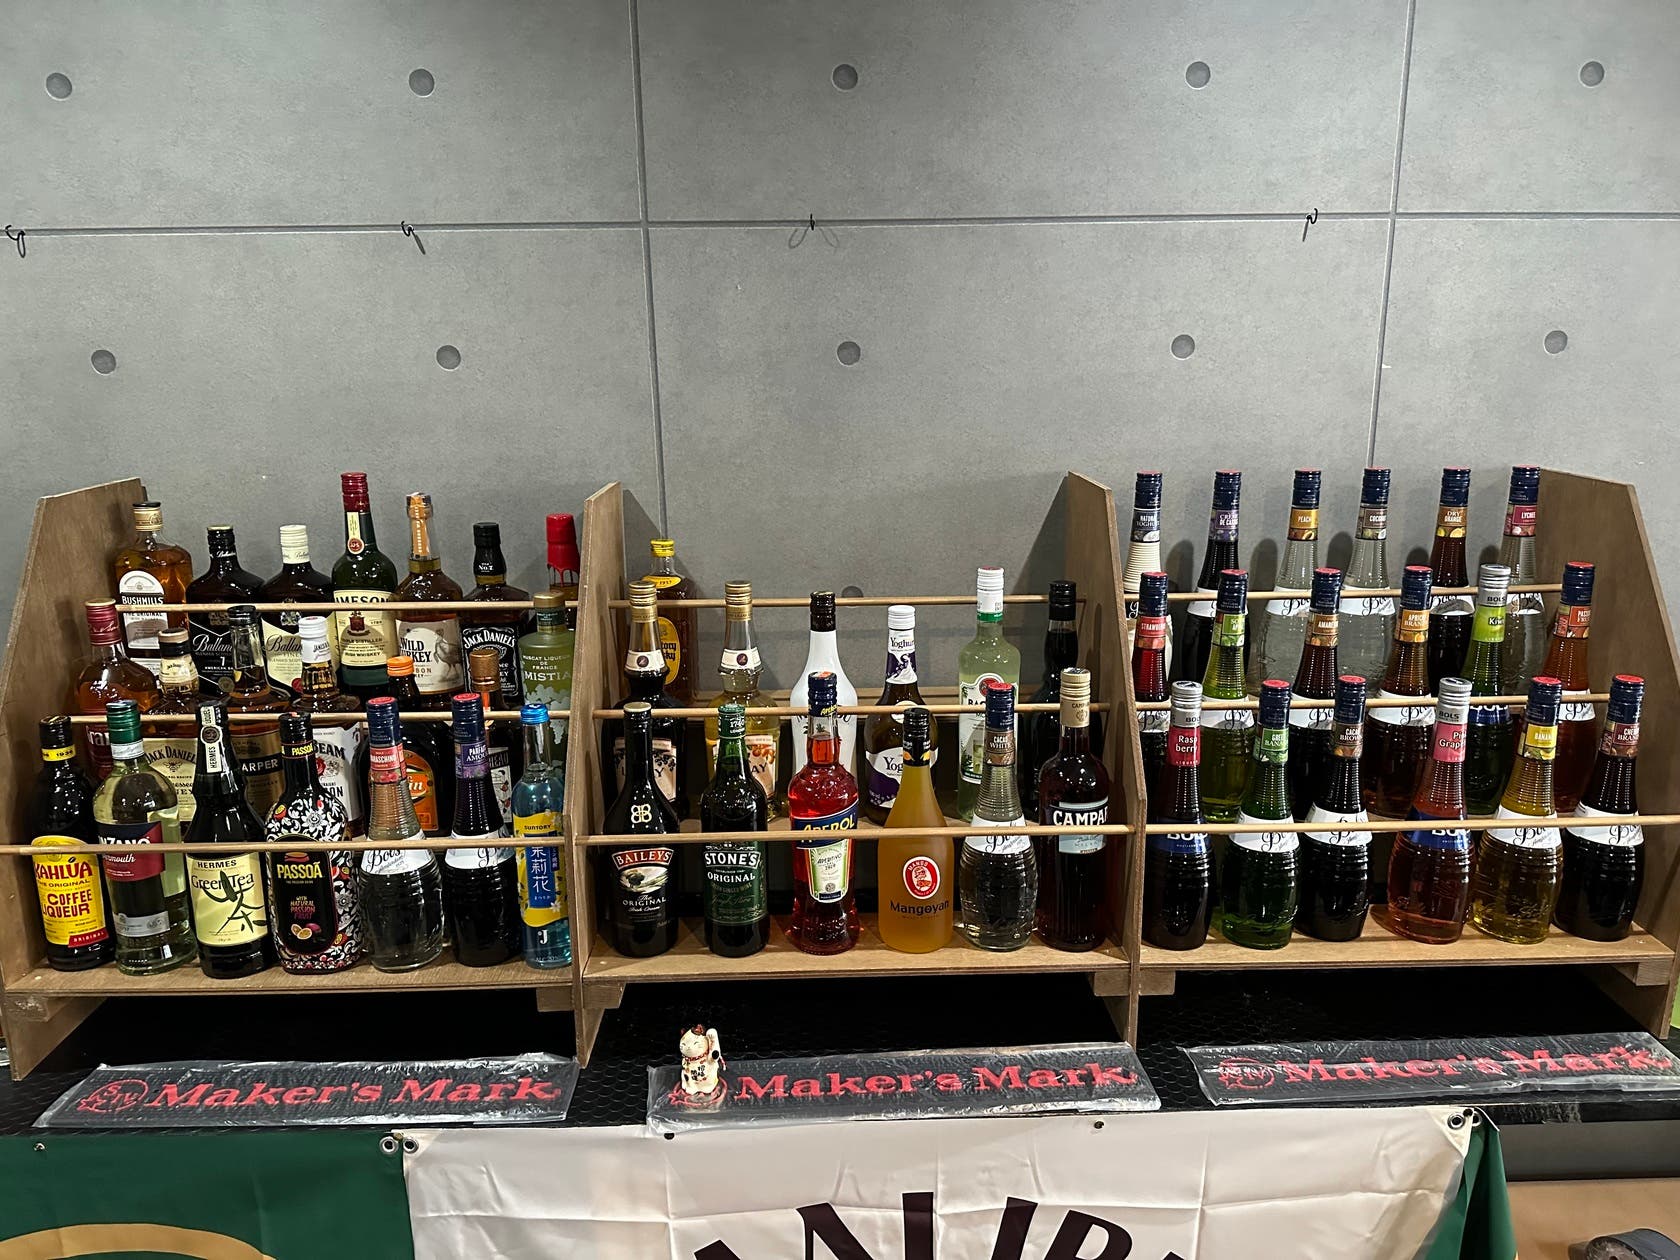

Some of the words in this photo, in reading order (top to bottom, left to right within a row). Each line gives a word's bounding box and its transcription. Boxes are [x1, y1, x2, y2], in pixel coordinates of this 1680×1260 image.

[121, 596, 164, 605] BUSHMILLS
[463, 636, 483, 649] JACK
[484, 631, 516, 648] DANIEL'S
[242, 758, 278, 772] ARPER
[197, 859, 238, 869] HERMES
[615, 851, 672, 866] BAILEYS
[704, 852, 759, 866] STONE'S
[276, 861, 323, 879] PASSOÃ
[707, 872, 756, 883] ORIGINAL
[48, 879, 91, 889] ORIGINAL
[228, 872, 255, 888] Tea
[47, 889, 93, 906] COFFEE
[622, 897, 667, 907] ORIGINAL
[890, 899, 950, 916] Mangoyan
[1275, 1055, 1506, 1084] Maker's
[733, 1070, 963, 1099] Maker's
[143, 1081, 383, 1107] Maker's
